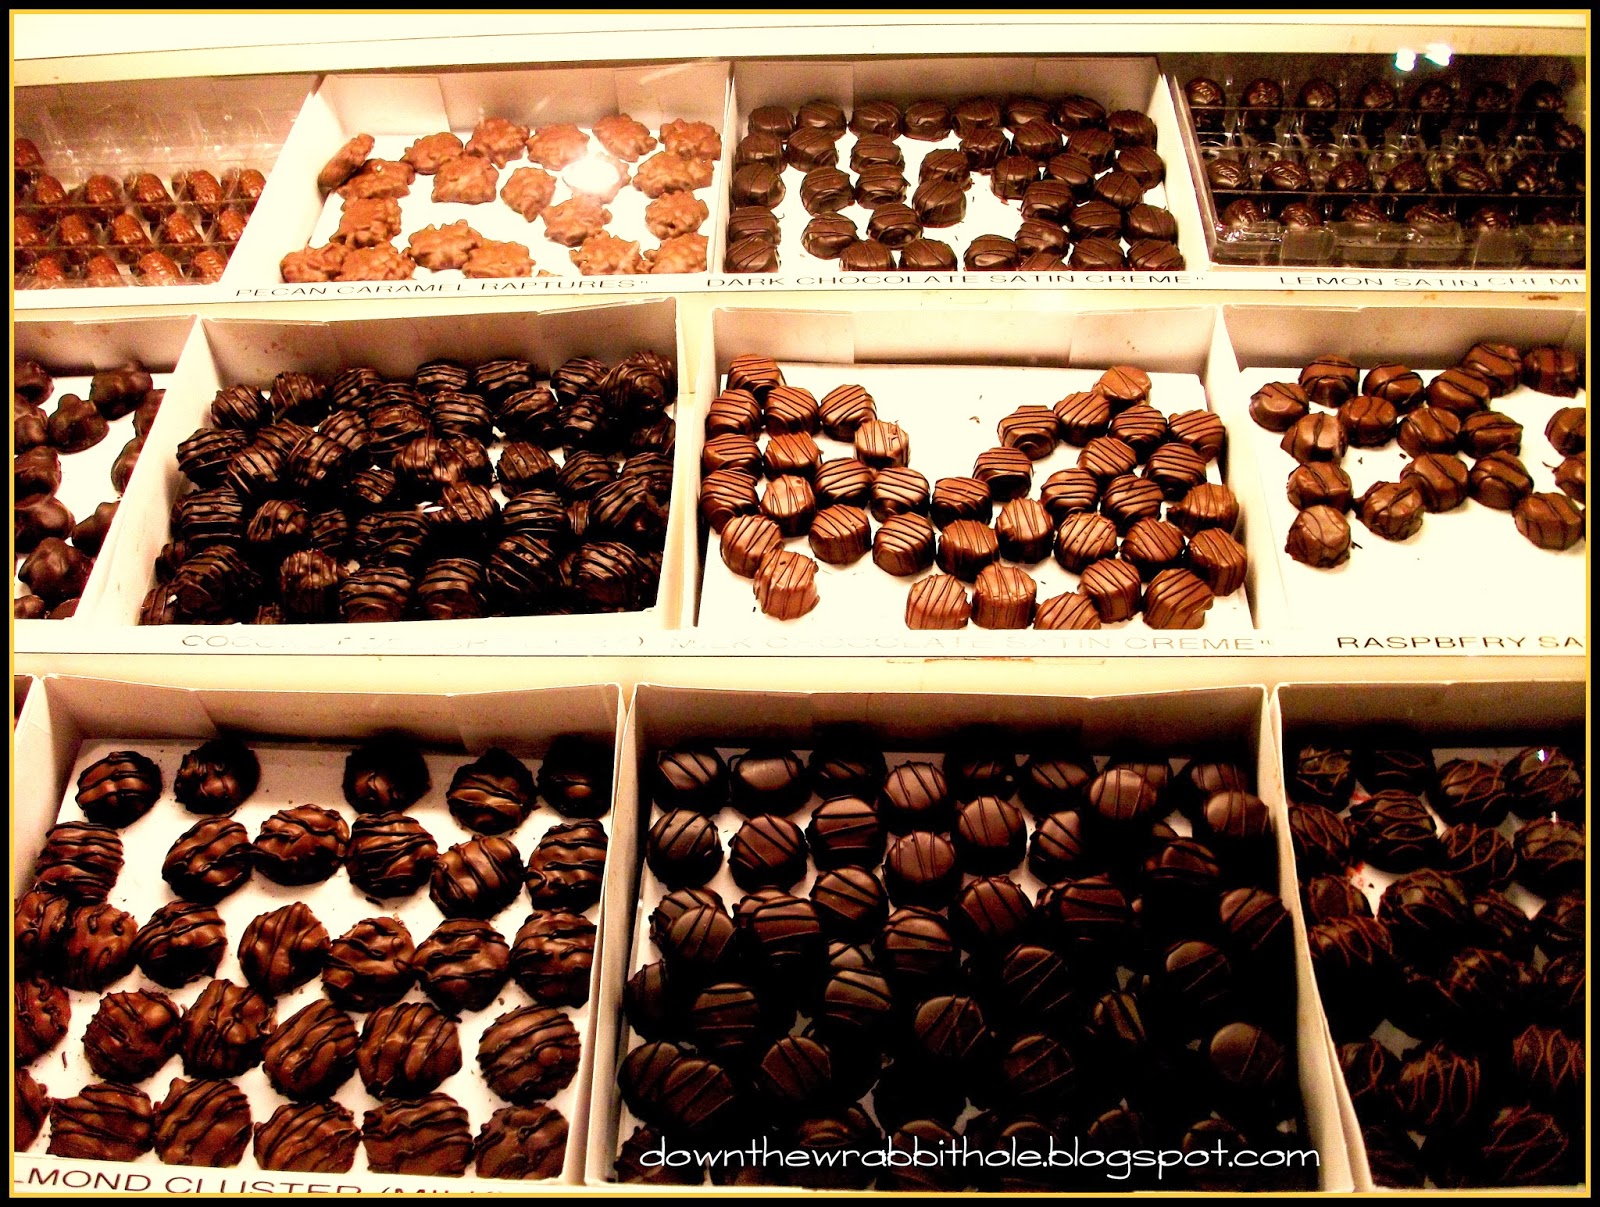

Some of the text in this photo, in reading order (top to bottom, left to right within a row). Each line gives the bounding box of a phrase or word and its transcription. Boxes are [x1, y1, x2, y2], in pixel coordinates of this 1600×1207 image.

[706, 275, 786, 287] DARK
[796, 275, 979, 286] CHOCOLATE
[989, 274, 1074, 284] SATIN
[1279, 276, 1383, 286] LEMON
[1393, 278, 1480, 288] SATIN
[235, 287, 328, 298] PECAN
[337, 284, 467, 294] CARAMEL
